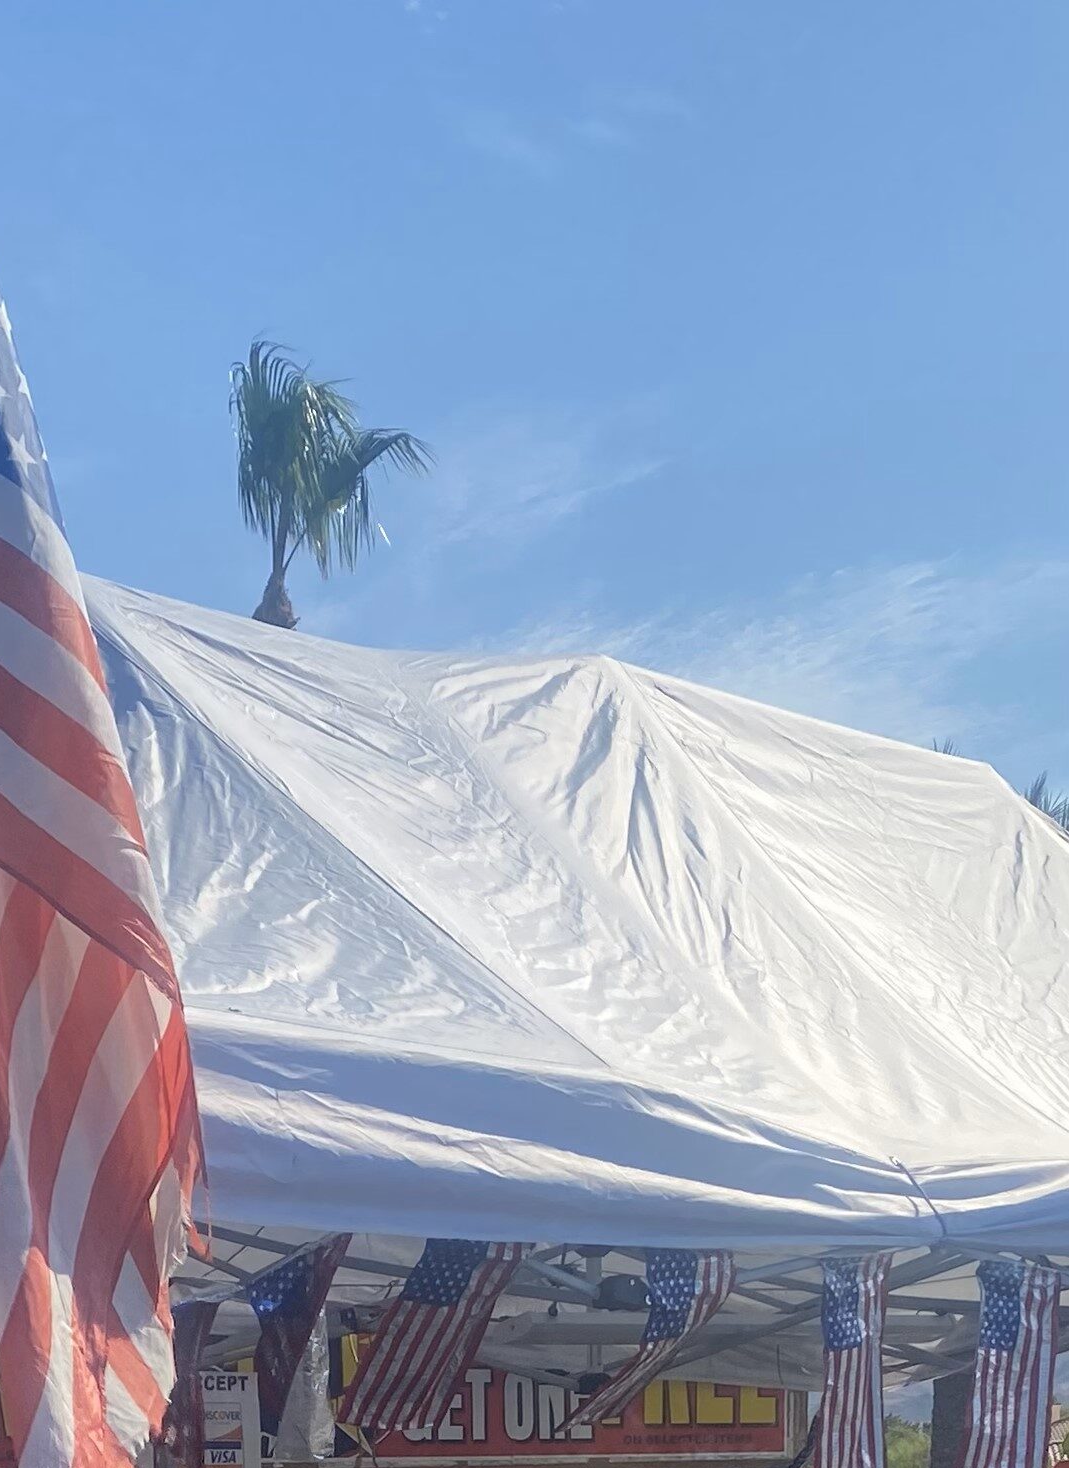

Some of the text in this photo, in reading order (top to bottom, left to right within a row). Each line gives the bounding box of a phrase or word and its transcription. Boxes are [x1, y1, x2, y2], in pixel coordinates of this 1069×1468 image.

[204, 1374, 248, 1391] CEPT
[205, 1410, 242, 1421] ISCOVER
[210, 1450, 237, 1463] VISA
